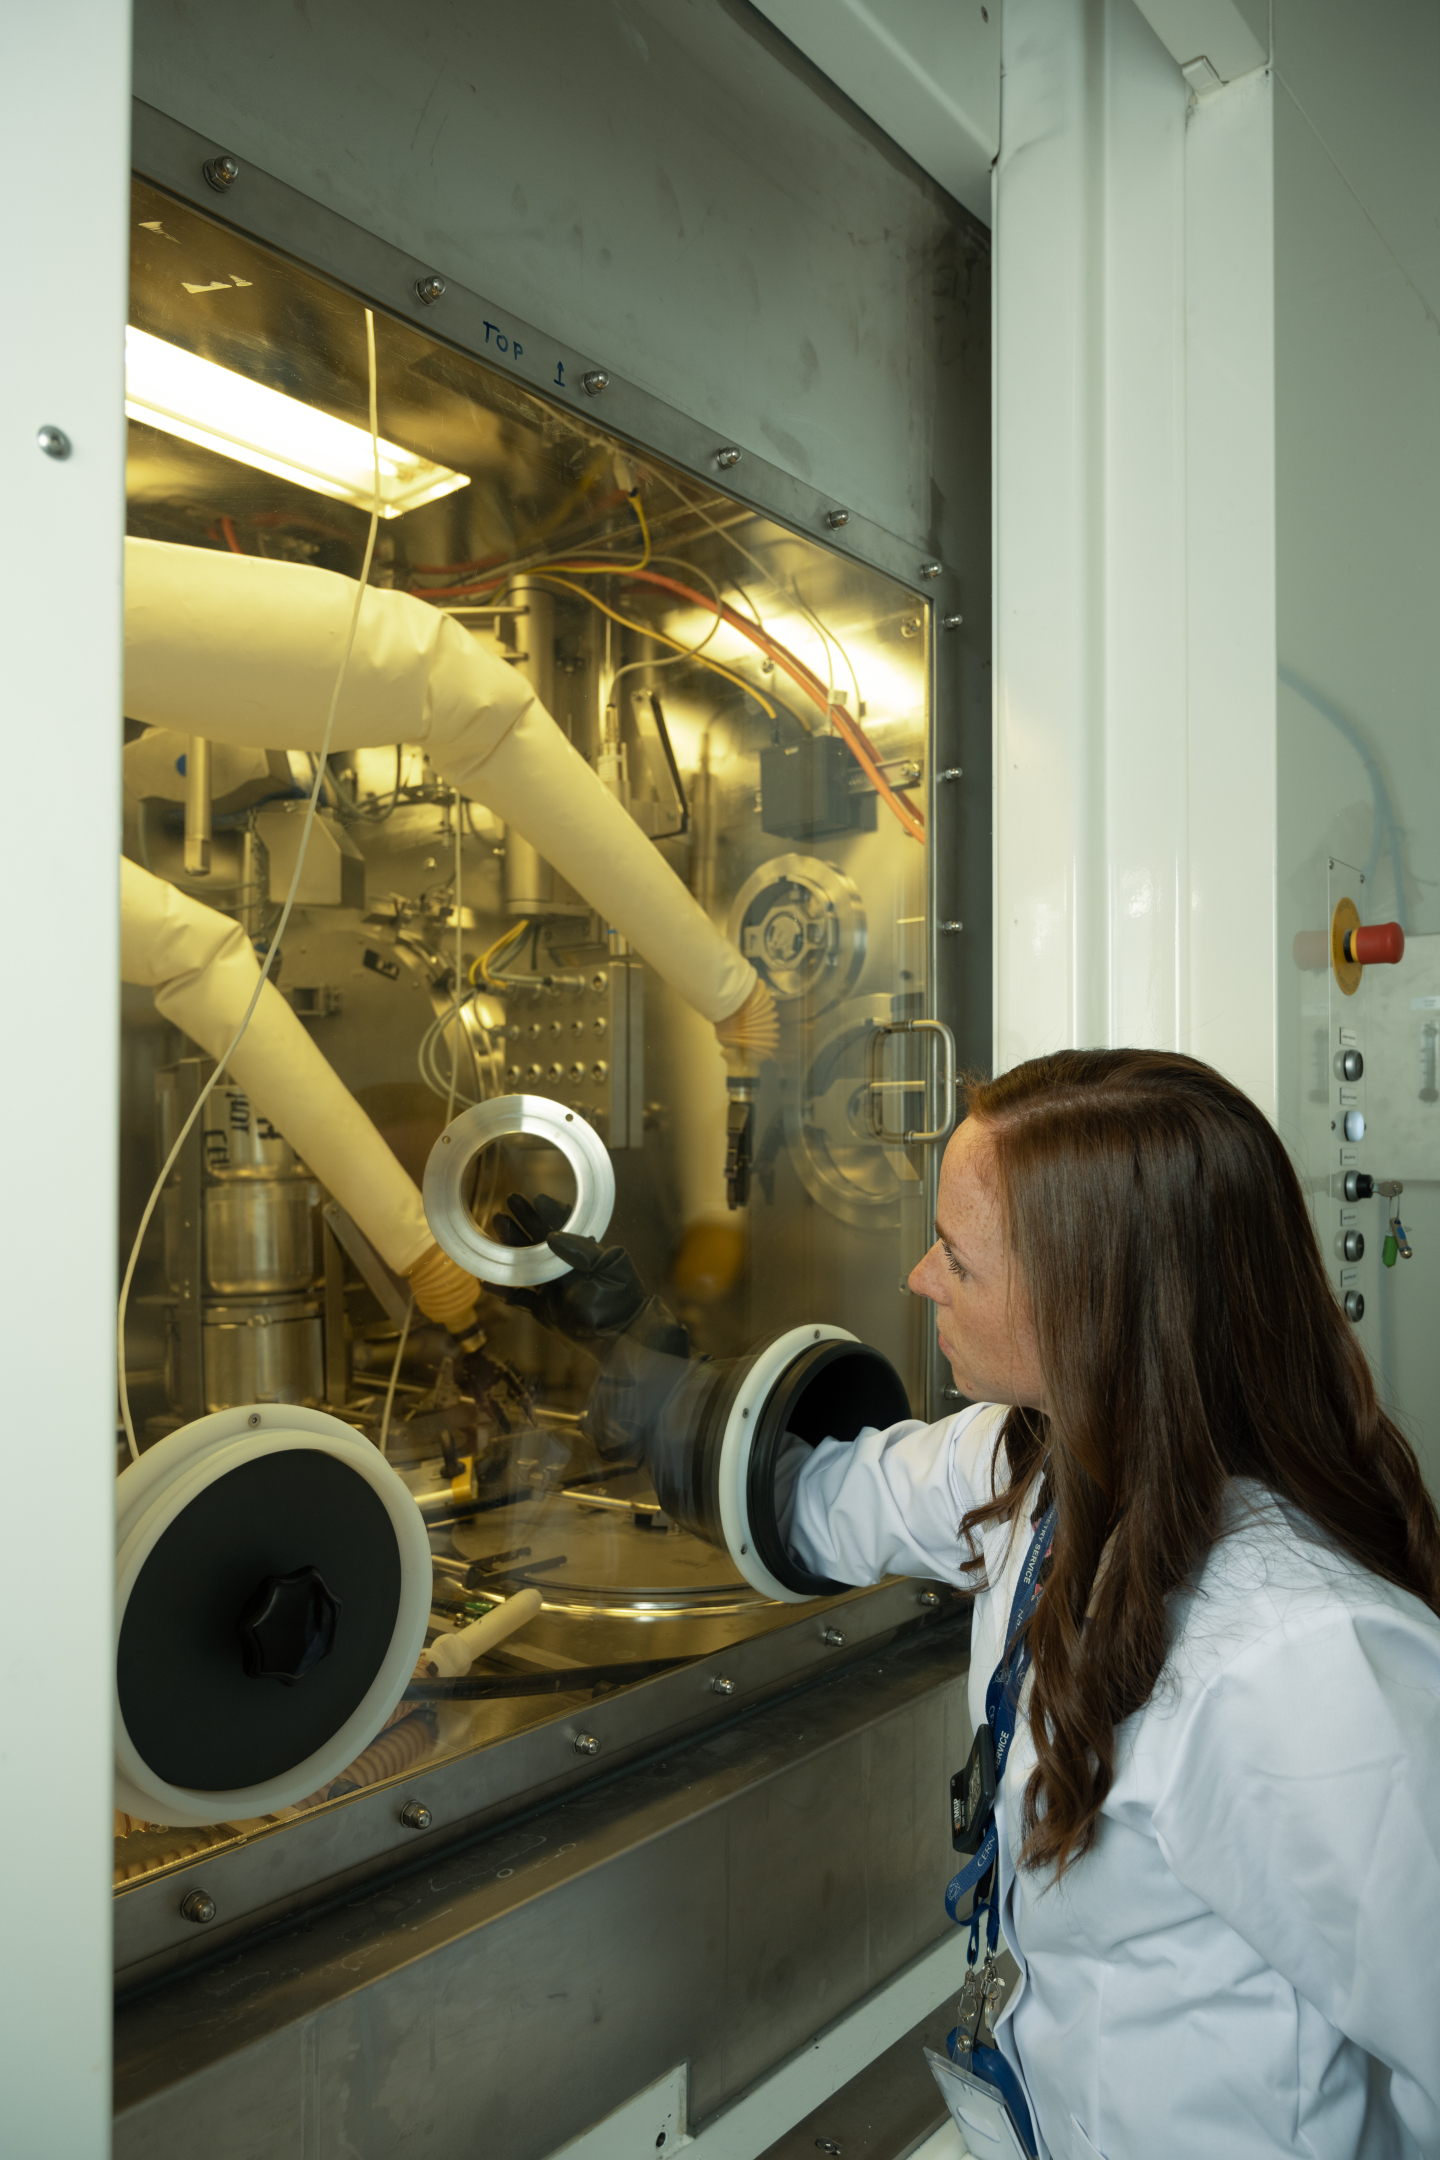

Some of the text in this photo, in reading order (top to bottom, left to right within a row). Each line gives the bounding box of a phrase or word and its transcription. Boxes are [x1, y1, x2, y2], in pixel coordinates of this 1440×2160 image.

[483, 320, 523, 360] TOP
[1023, 1543, 1041, 1585] SERVICE
[977, 1835, 996, 1867] CERN
